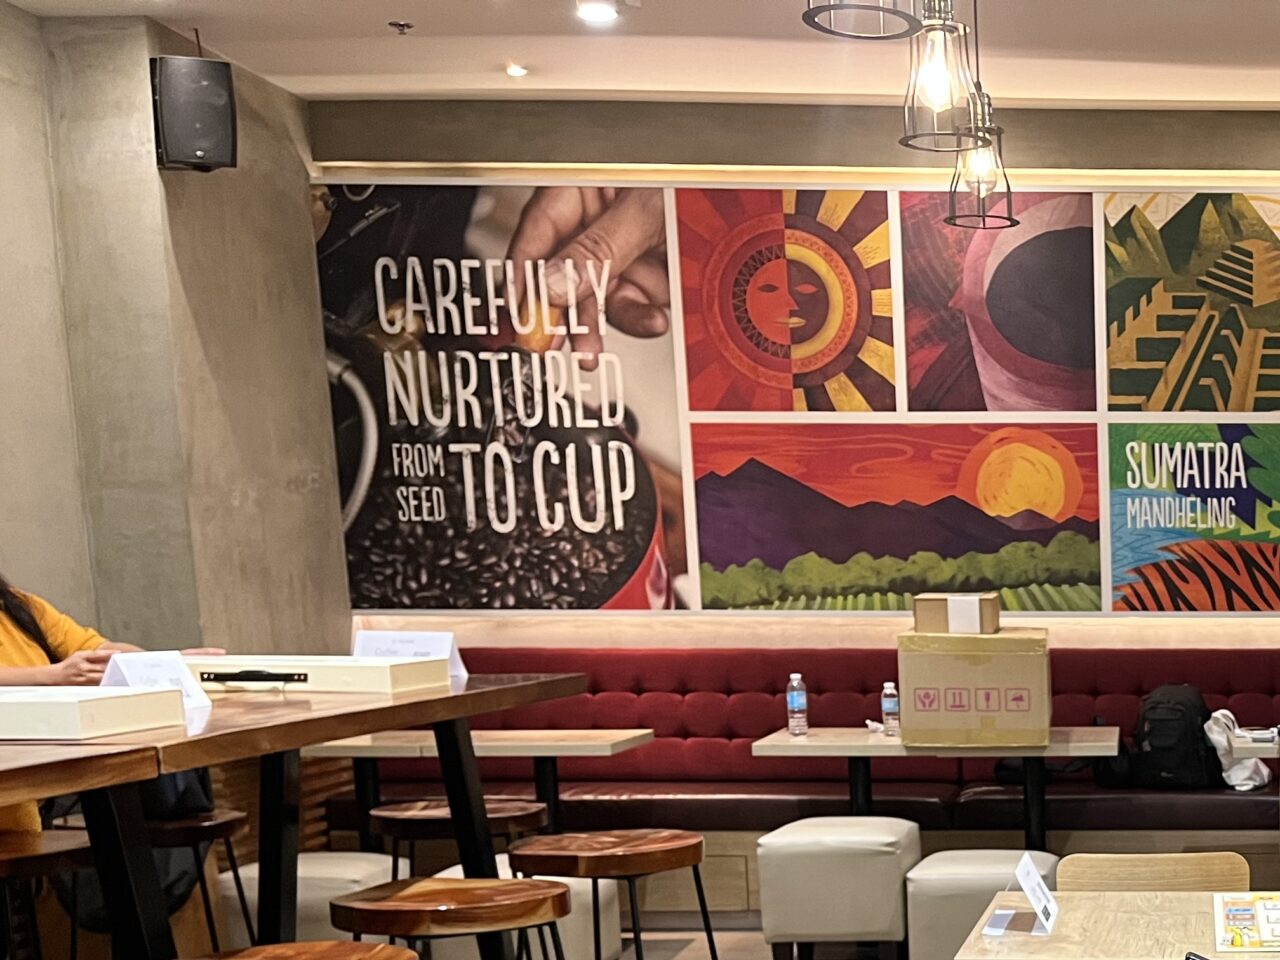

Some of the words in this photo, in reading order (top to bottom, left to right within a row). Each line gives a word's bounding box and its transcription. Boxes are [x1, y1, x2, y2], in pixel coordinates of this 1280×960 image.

[374, 257, 611, 336] CAREFULLY
[384, 351, 626, 428] NURTURED
[392, 443, 446, 478] FROM
[1126, 441, 1247, 490] SUMATRA
[396, 485, 446, 522] SEED
[449, 441, 517, 533] TO
[533, 440, 635, 532] CUP
[1127, 496, 1236, 529] MANDHELING
